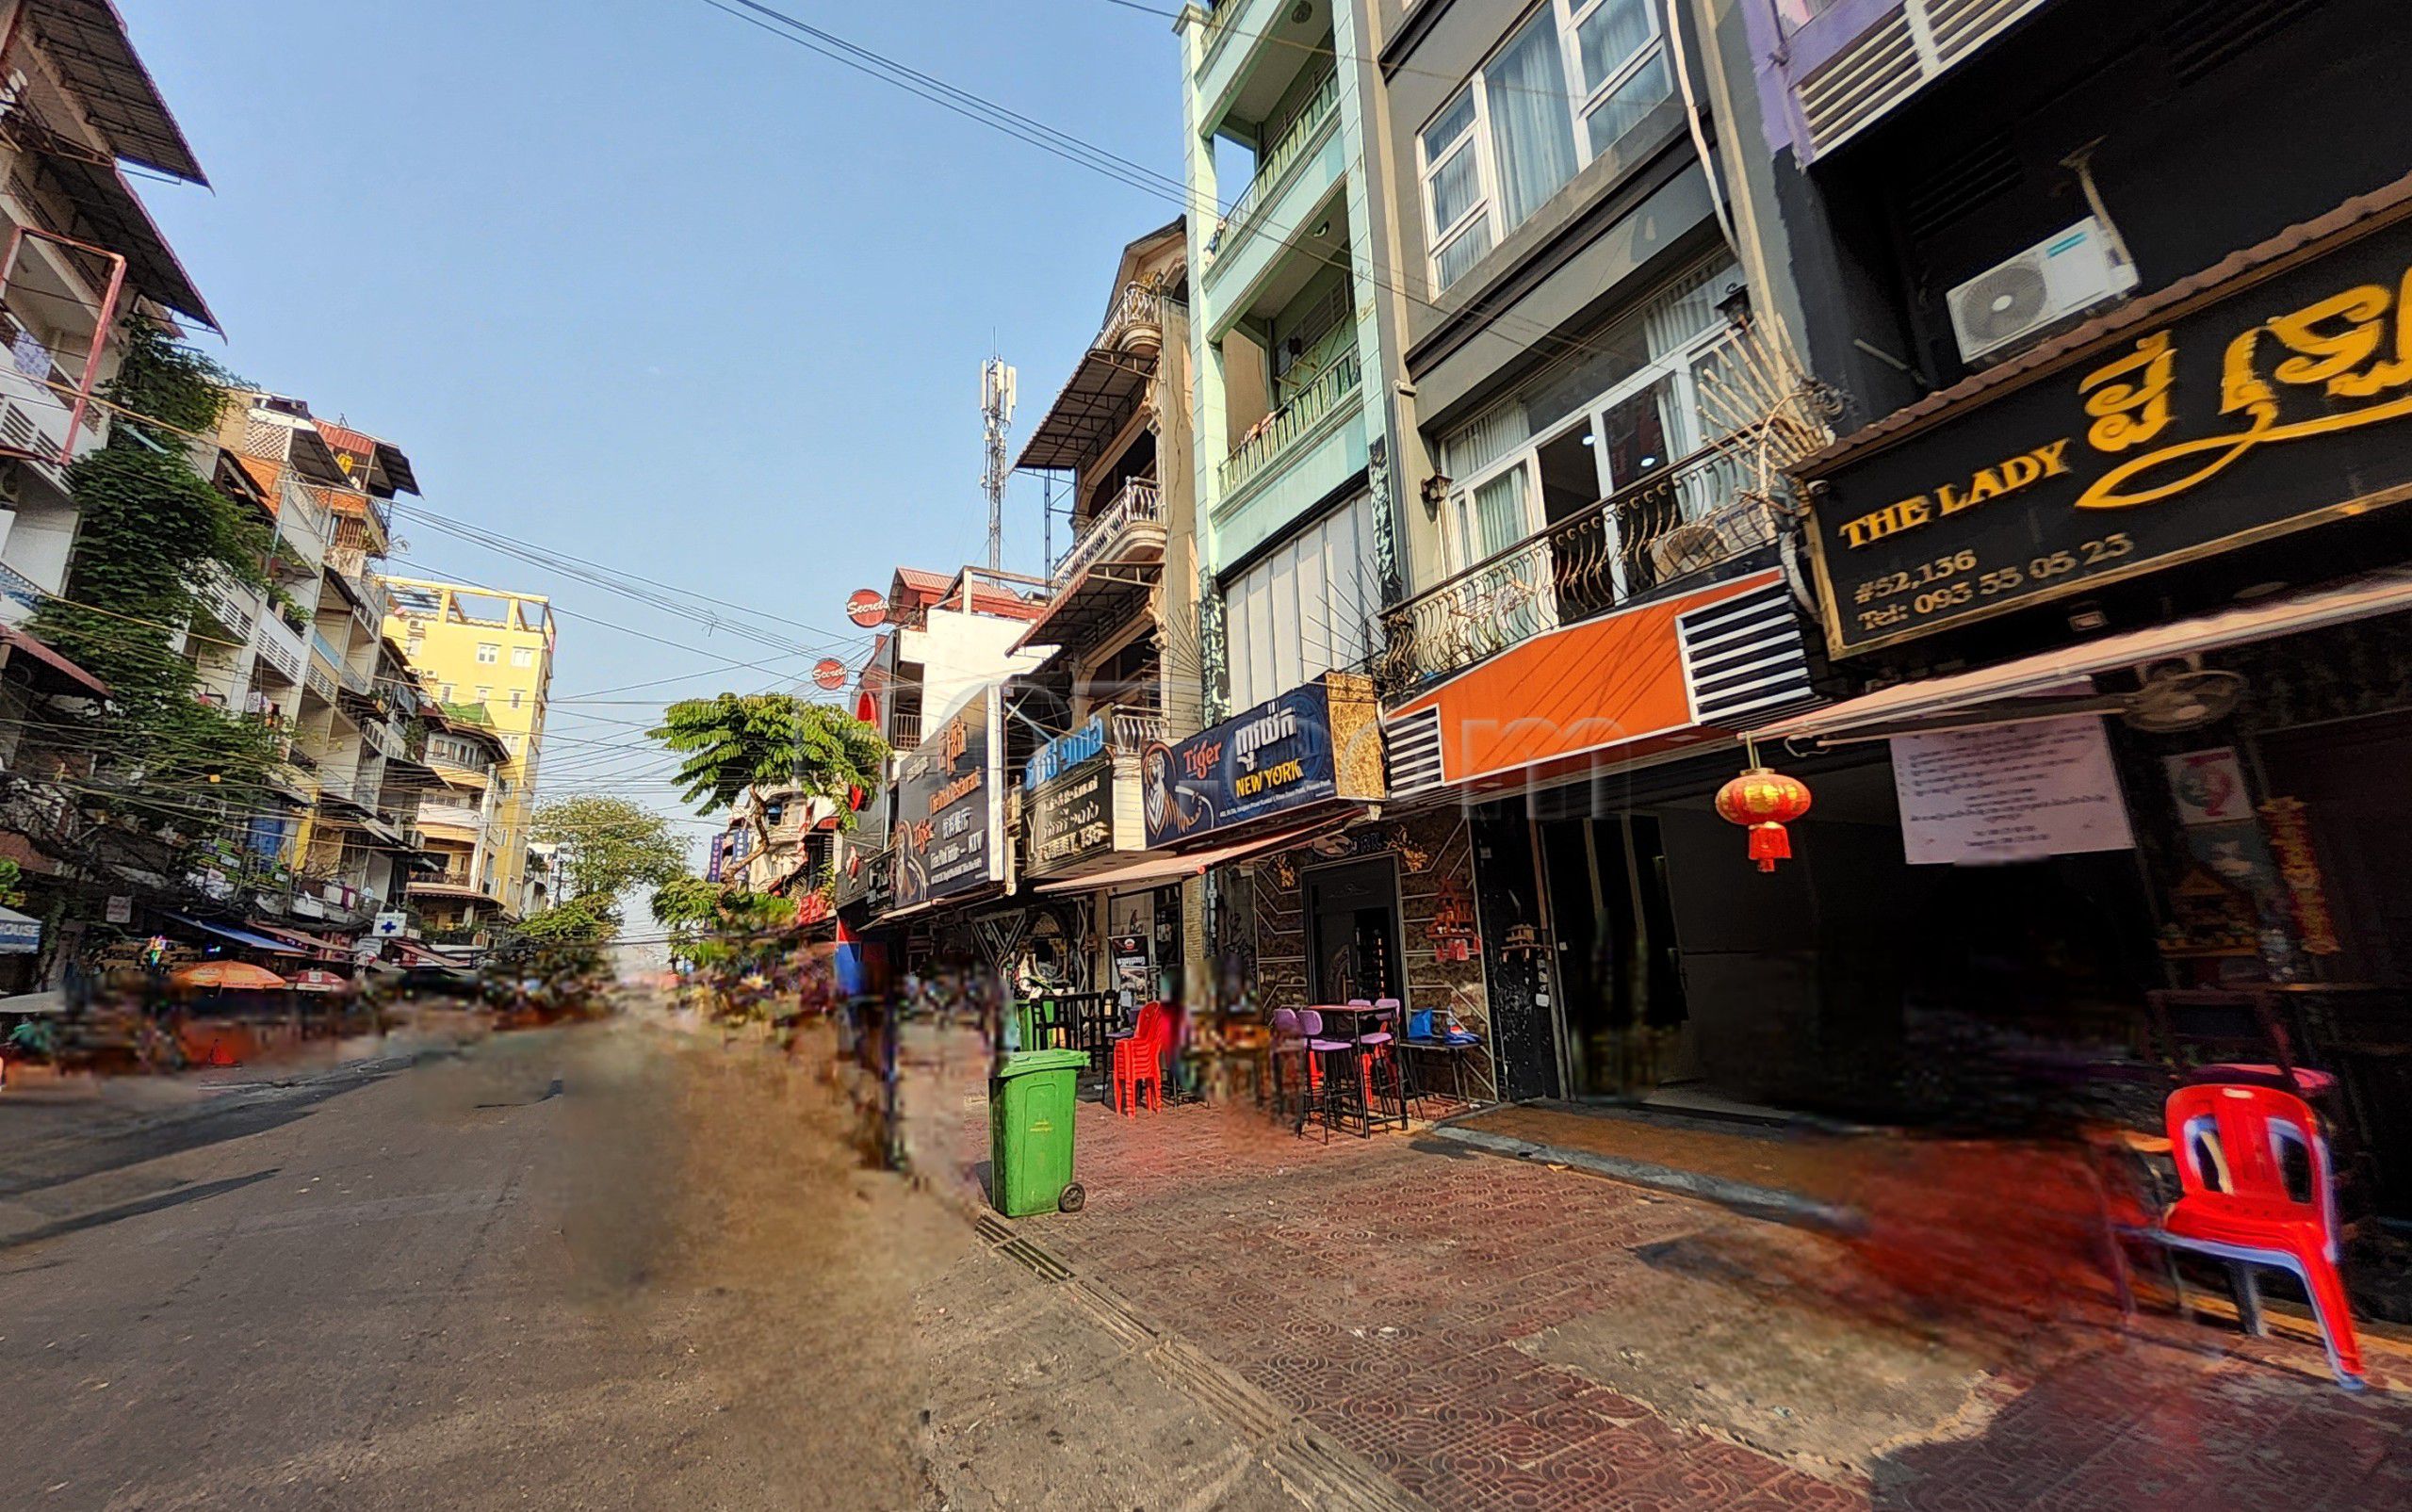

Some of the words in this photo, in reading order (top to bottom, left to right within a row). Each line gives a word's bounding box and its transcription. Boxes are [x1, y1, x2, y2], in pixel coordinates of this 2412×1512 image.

[1838, 495, 1931, 549] THE
[1934, 437, 2072, 517] LADY
[1182, 740, 1223, 780] Tiger
[1235, 772, 1263, 799] NEW
[1263, 757, 1305, 789] YORK
[968, 829, 985, 854] KTV
